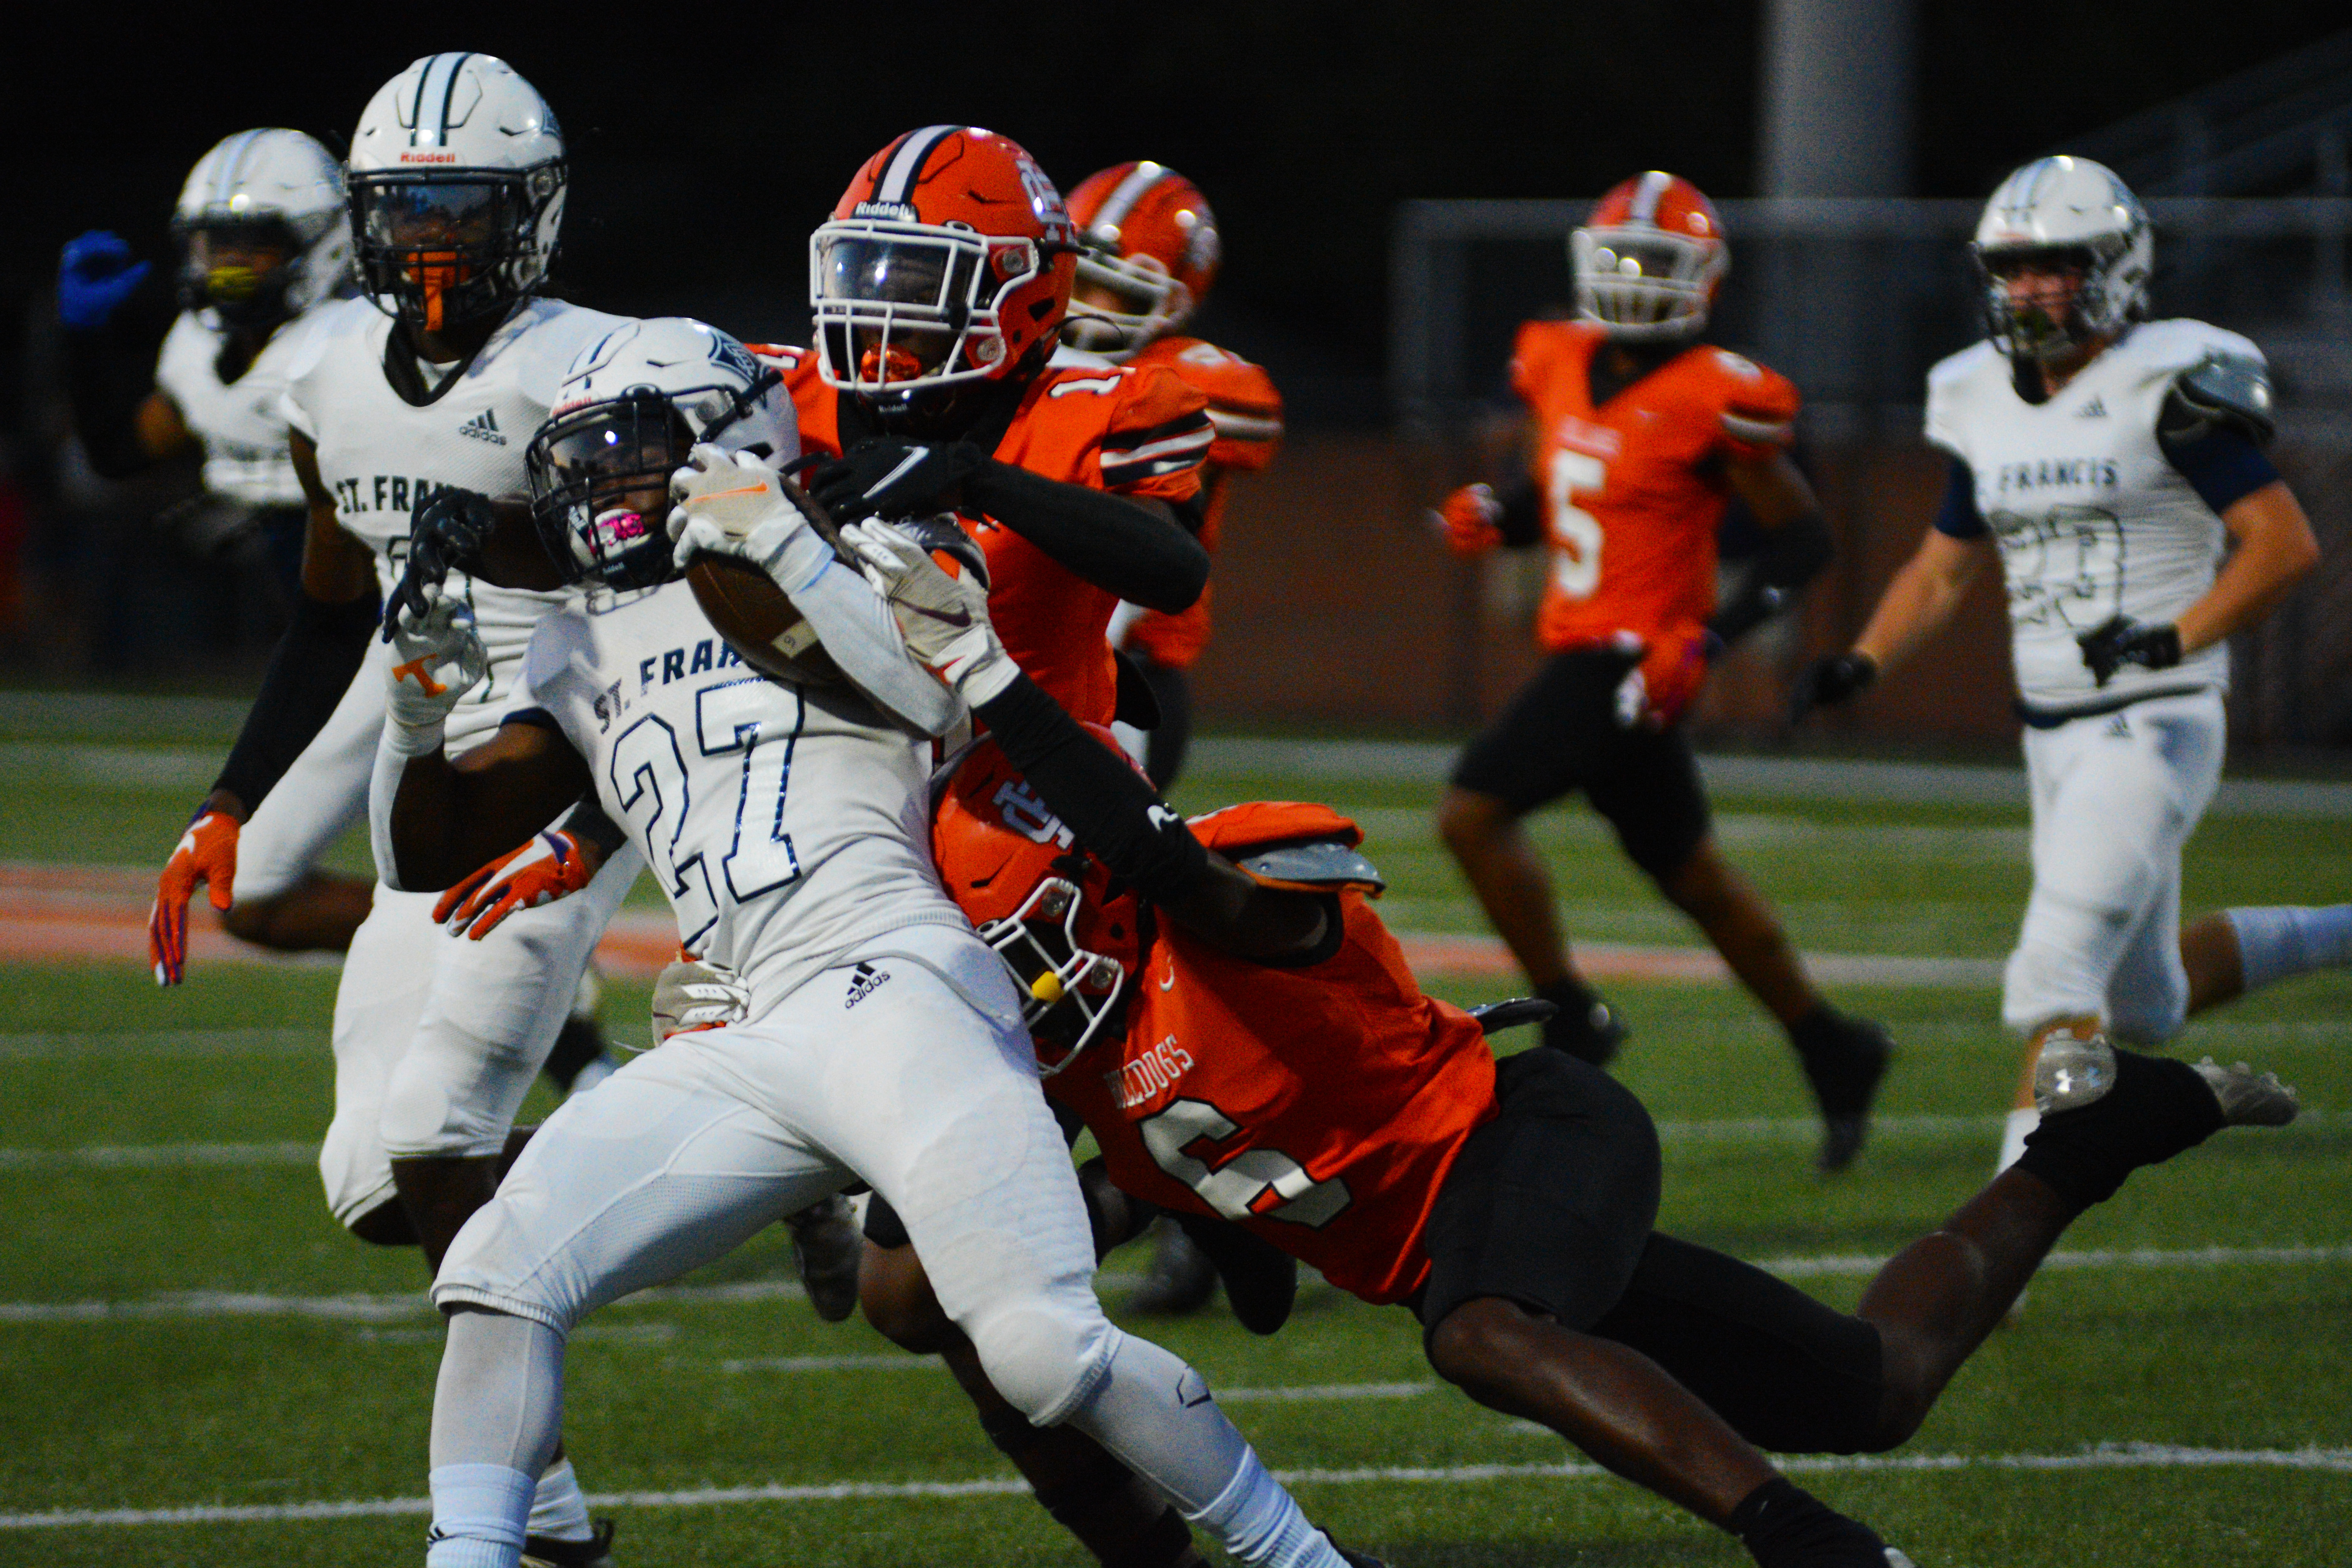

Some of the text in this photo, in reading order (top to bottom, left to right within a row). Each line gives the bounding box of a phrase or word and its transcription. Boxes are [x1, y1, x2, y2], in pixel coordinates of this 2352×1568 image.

[400, 152, 456, 163] Riddell
[855, 201, 910, 217] Riddell
[1049, 374, 1124, 398] 1
[459, 426, 507, 446] adidas
[2000, 458, 2119, 491] FRANCIS
[1548, 446, 1608, 600] 5
[392, 651, 447, 698] T
[593, 677, 630, 735] ST.
[610, 681, 805, 950] 27
[845, 971, 891, 1009] adidas
[1137, 1096, 1354, 1232] 6
